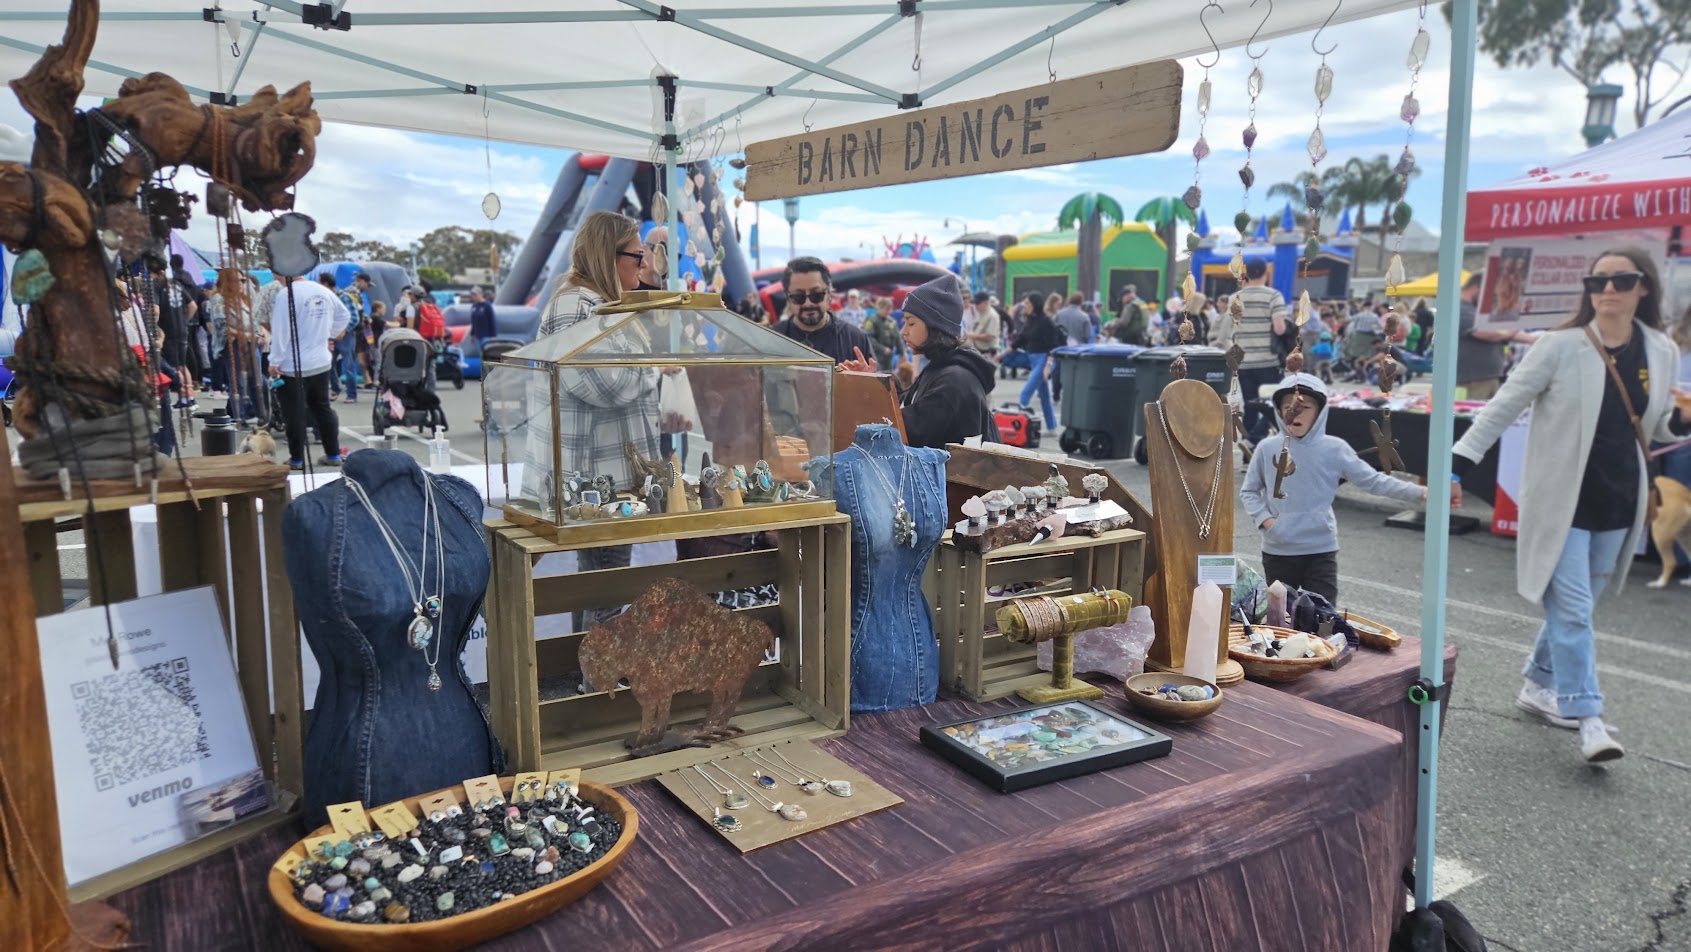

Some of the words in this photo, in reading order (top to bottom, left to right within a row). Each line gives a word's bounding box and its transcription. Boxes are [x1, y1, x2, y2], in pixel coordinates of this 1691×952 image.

[798, 127, 882, 186] BARN
[904, 95, 1050, 171] DANCE
[1490, 193, 1622, 229] PERSONALIZE
[1633, 186, 1691, 217] WITH
[118, 628, 152, 641] Rowe
[127, 776, 193, 808] venmo
